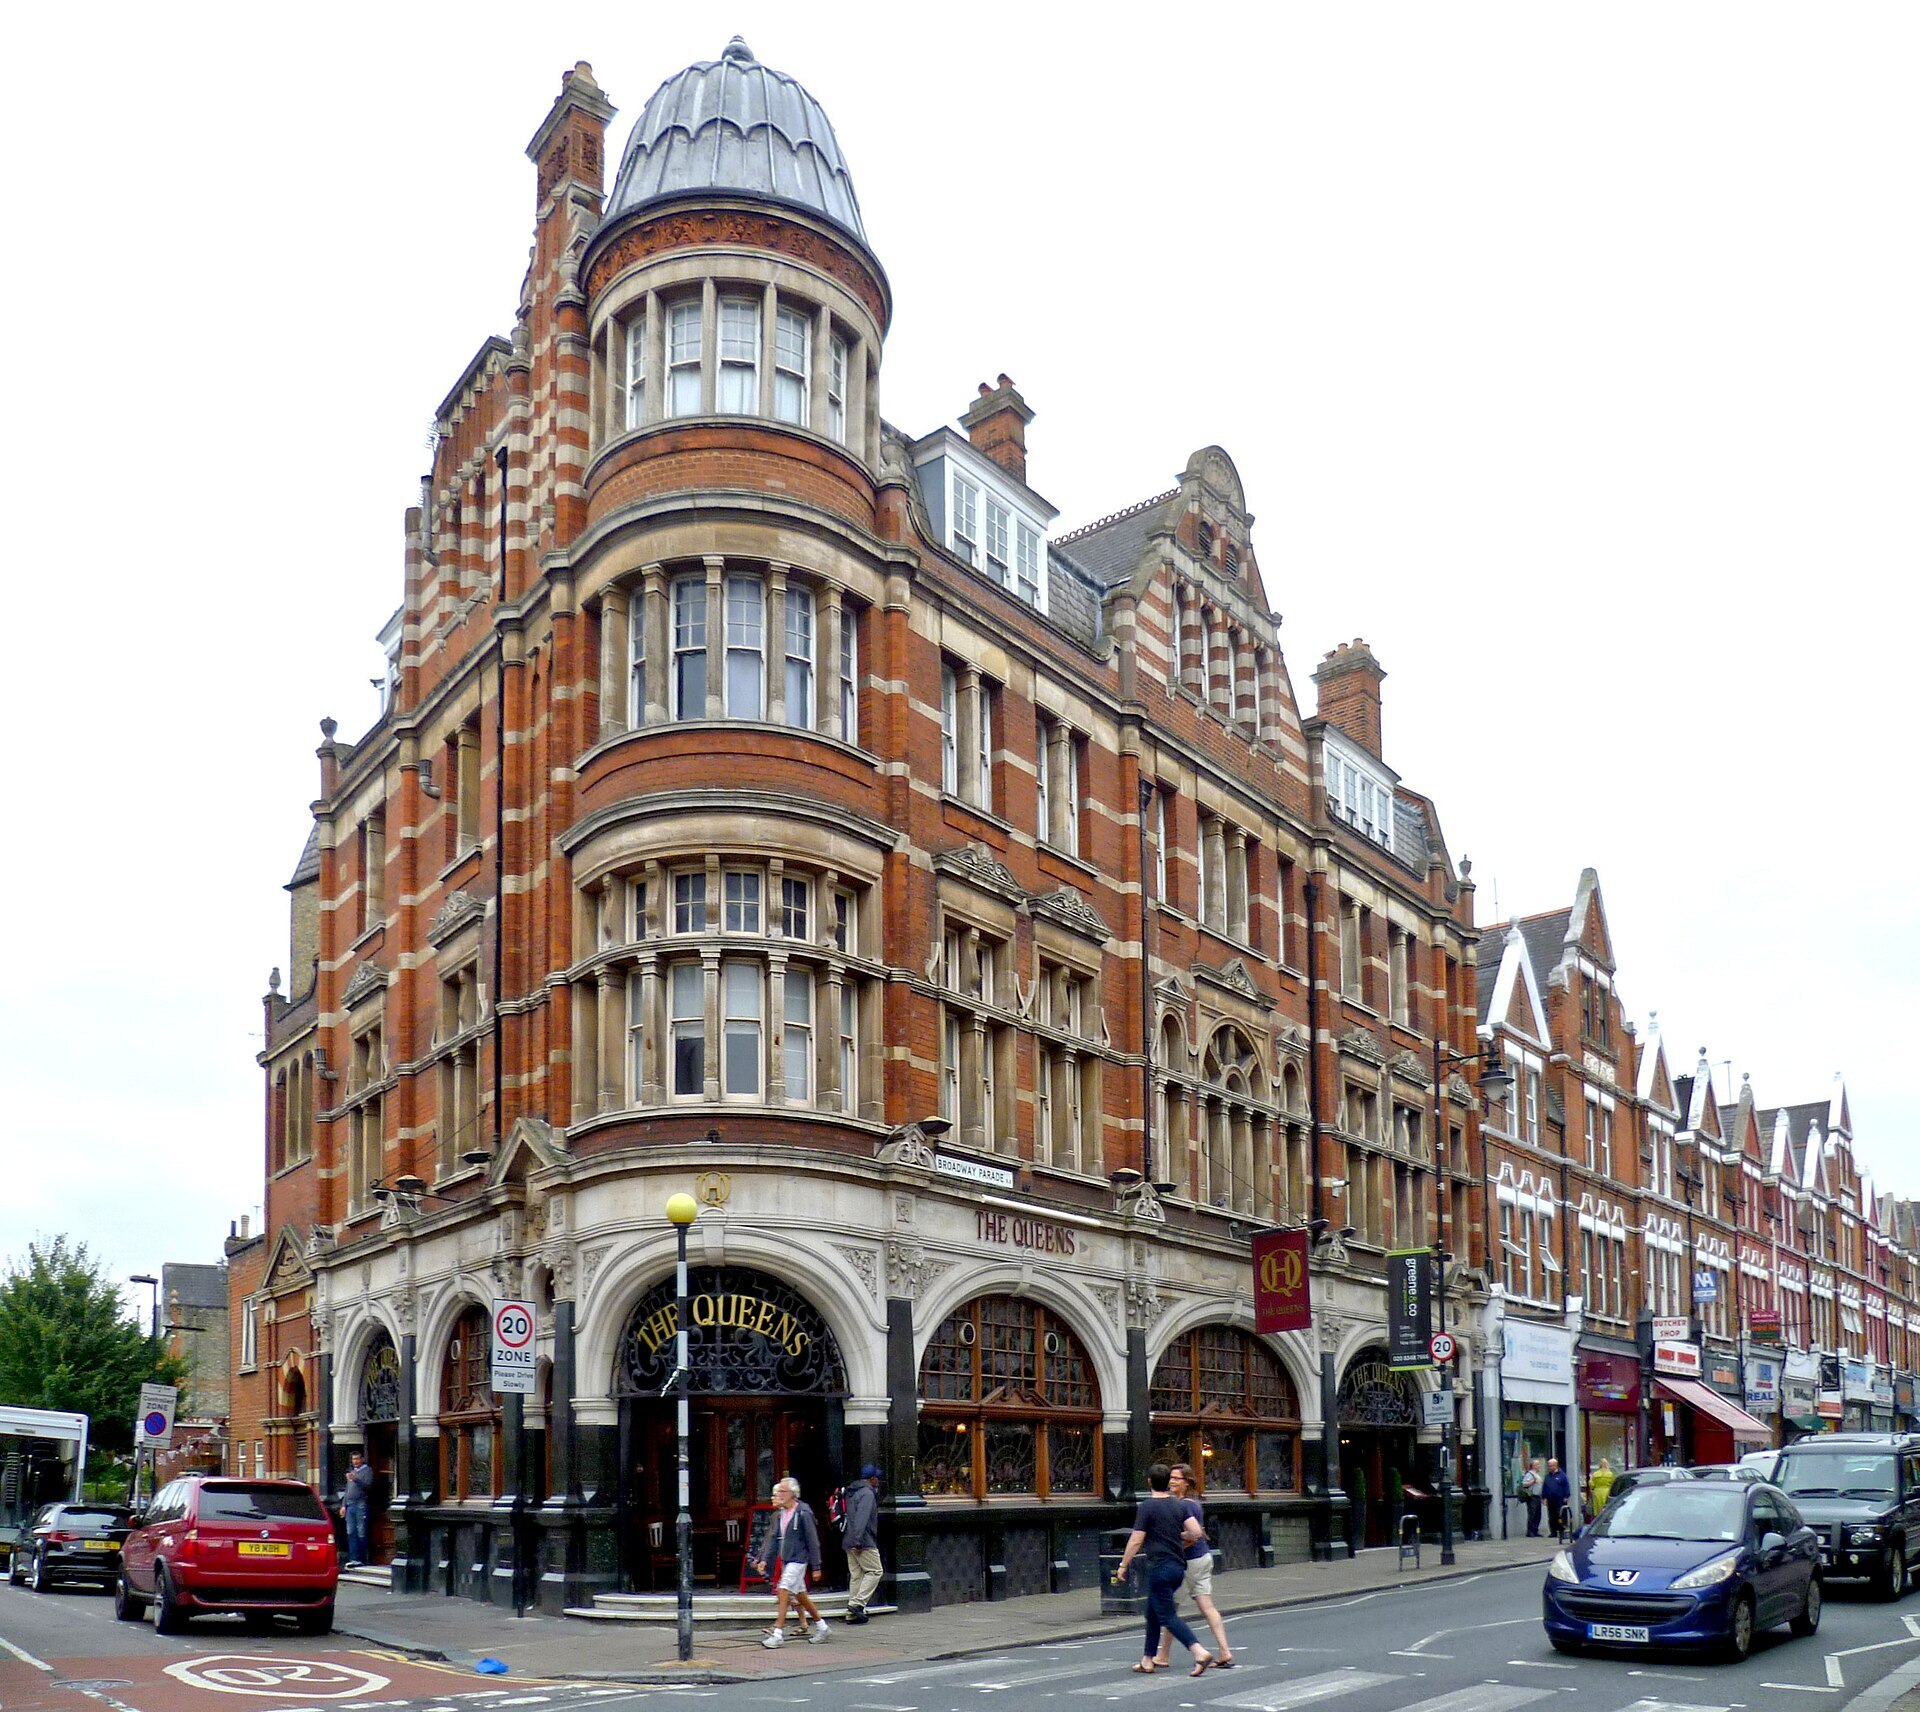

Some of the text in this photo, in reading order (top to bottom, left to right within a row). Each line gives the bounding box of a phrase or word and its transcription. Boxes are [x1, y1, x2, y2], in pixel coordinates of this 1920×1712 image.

[937, 1158, 976, 1177] BROADWAY
[978, 1168, 1004, 1183] PARADE
[975, 1210, 1076, 1256] THE QUEENS
[502, 1316, 528, 1335] 20
[637, 1294, 812, 1357] THE QUEENS
[1653, 1319, 1687, 1327] BUTCHER
[1660, 1329, 1680, 1337] SHOP
[1433, 1341, 1451, 1353] 20
[497, 1350, 531, 1363] ZONE
[494, 1370, 534, 1379] Please Drive
[503, 1381, 525, 1389] Slowly
[1747, 1391, 1774, 1401] REAL
[147, 1402, 169, 1411] ZONE
[1594, 1626, 1646, 1639] LR56 SNK
[202, 1666, 349, 1685] 20
